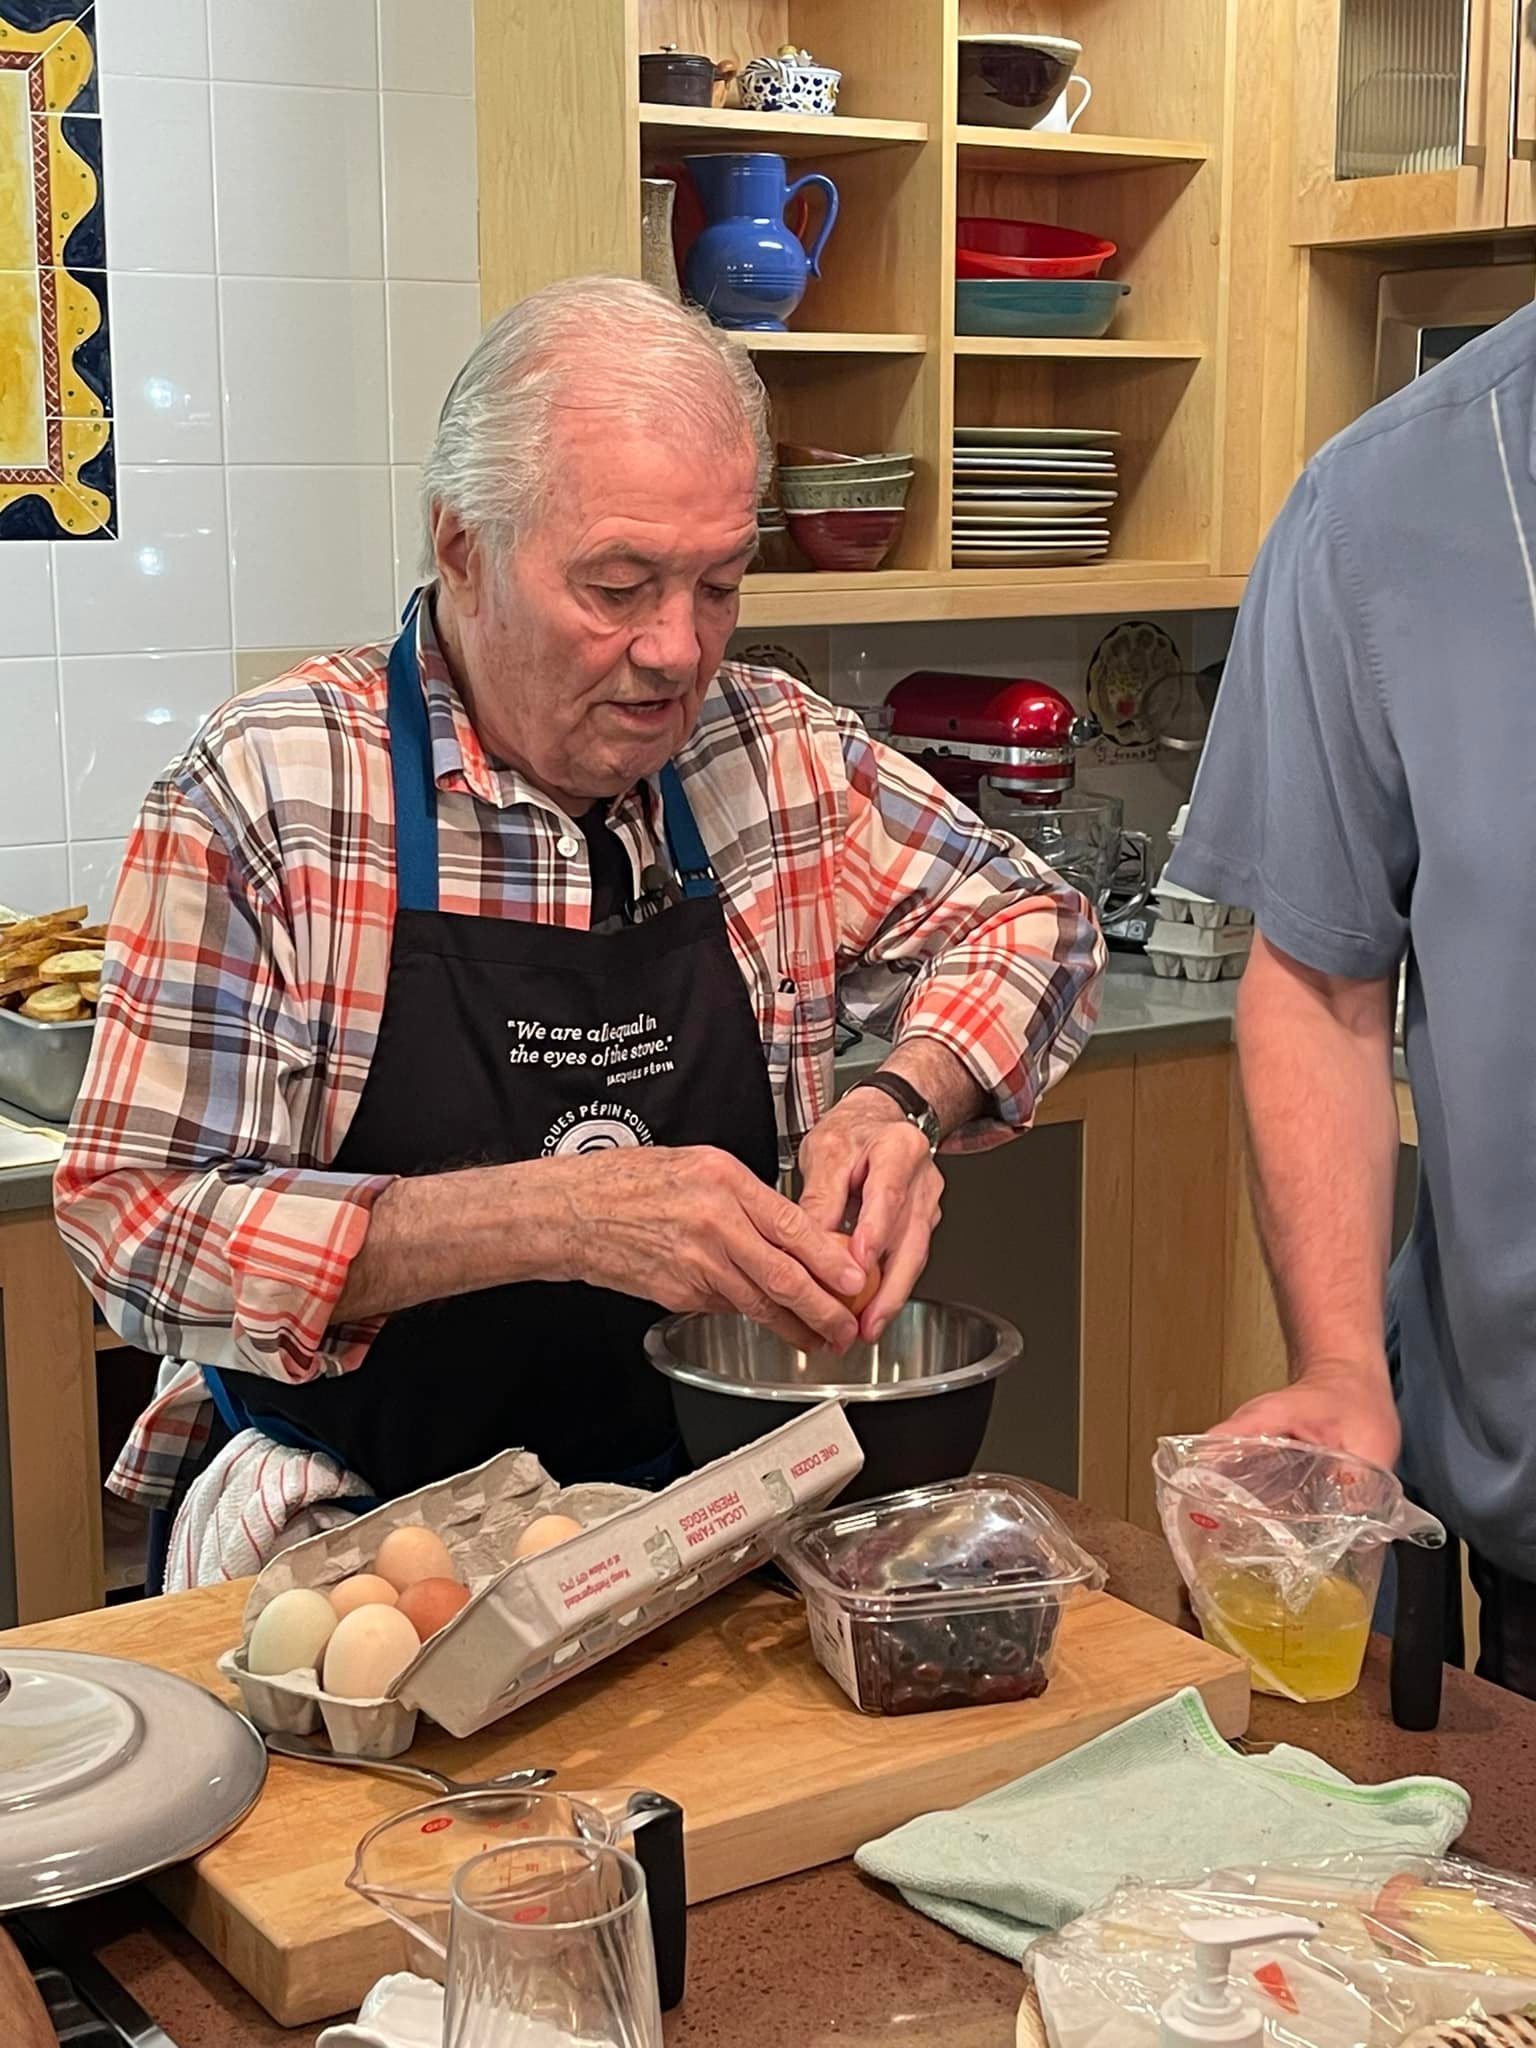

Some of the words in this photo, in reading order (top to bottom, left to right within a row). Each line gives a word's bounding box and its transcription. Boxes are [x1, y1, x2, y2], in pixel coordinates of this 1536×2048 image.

[551, 1027, 582, 1041] are
[609, 1013, 644, 1043] equal
[646, 1014, 657, 1032] in
[509, 1044, 539, 1063] the
[543, 1051, 587, 1068] eyes
[591, 1046, 610, 1067] of
[610, 1043, 629, 1064] the
[579, 1100, 622, 1118] PÉPIN
[822, 1443, 840, 1462] ONE
[790, 1453, 821, 1480] DOZEN
[709, 1490, 740, 1516] FRESH
[679, 1508, 709, 1531] EGGS
[717, 1504, 748, 1530] LOCAL
[686, 1523, 716, 1547] FARM
